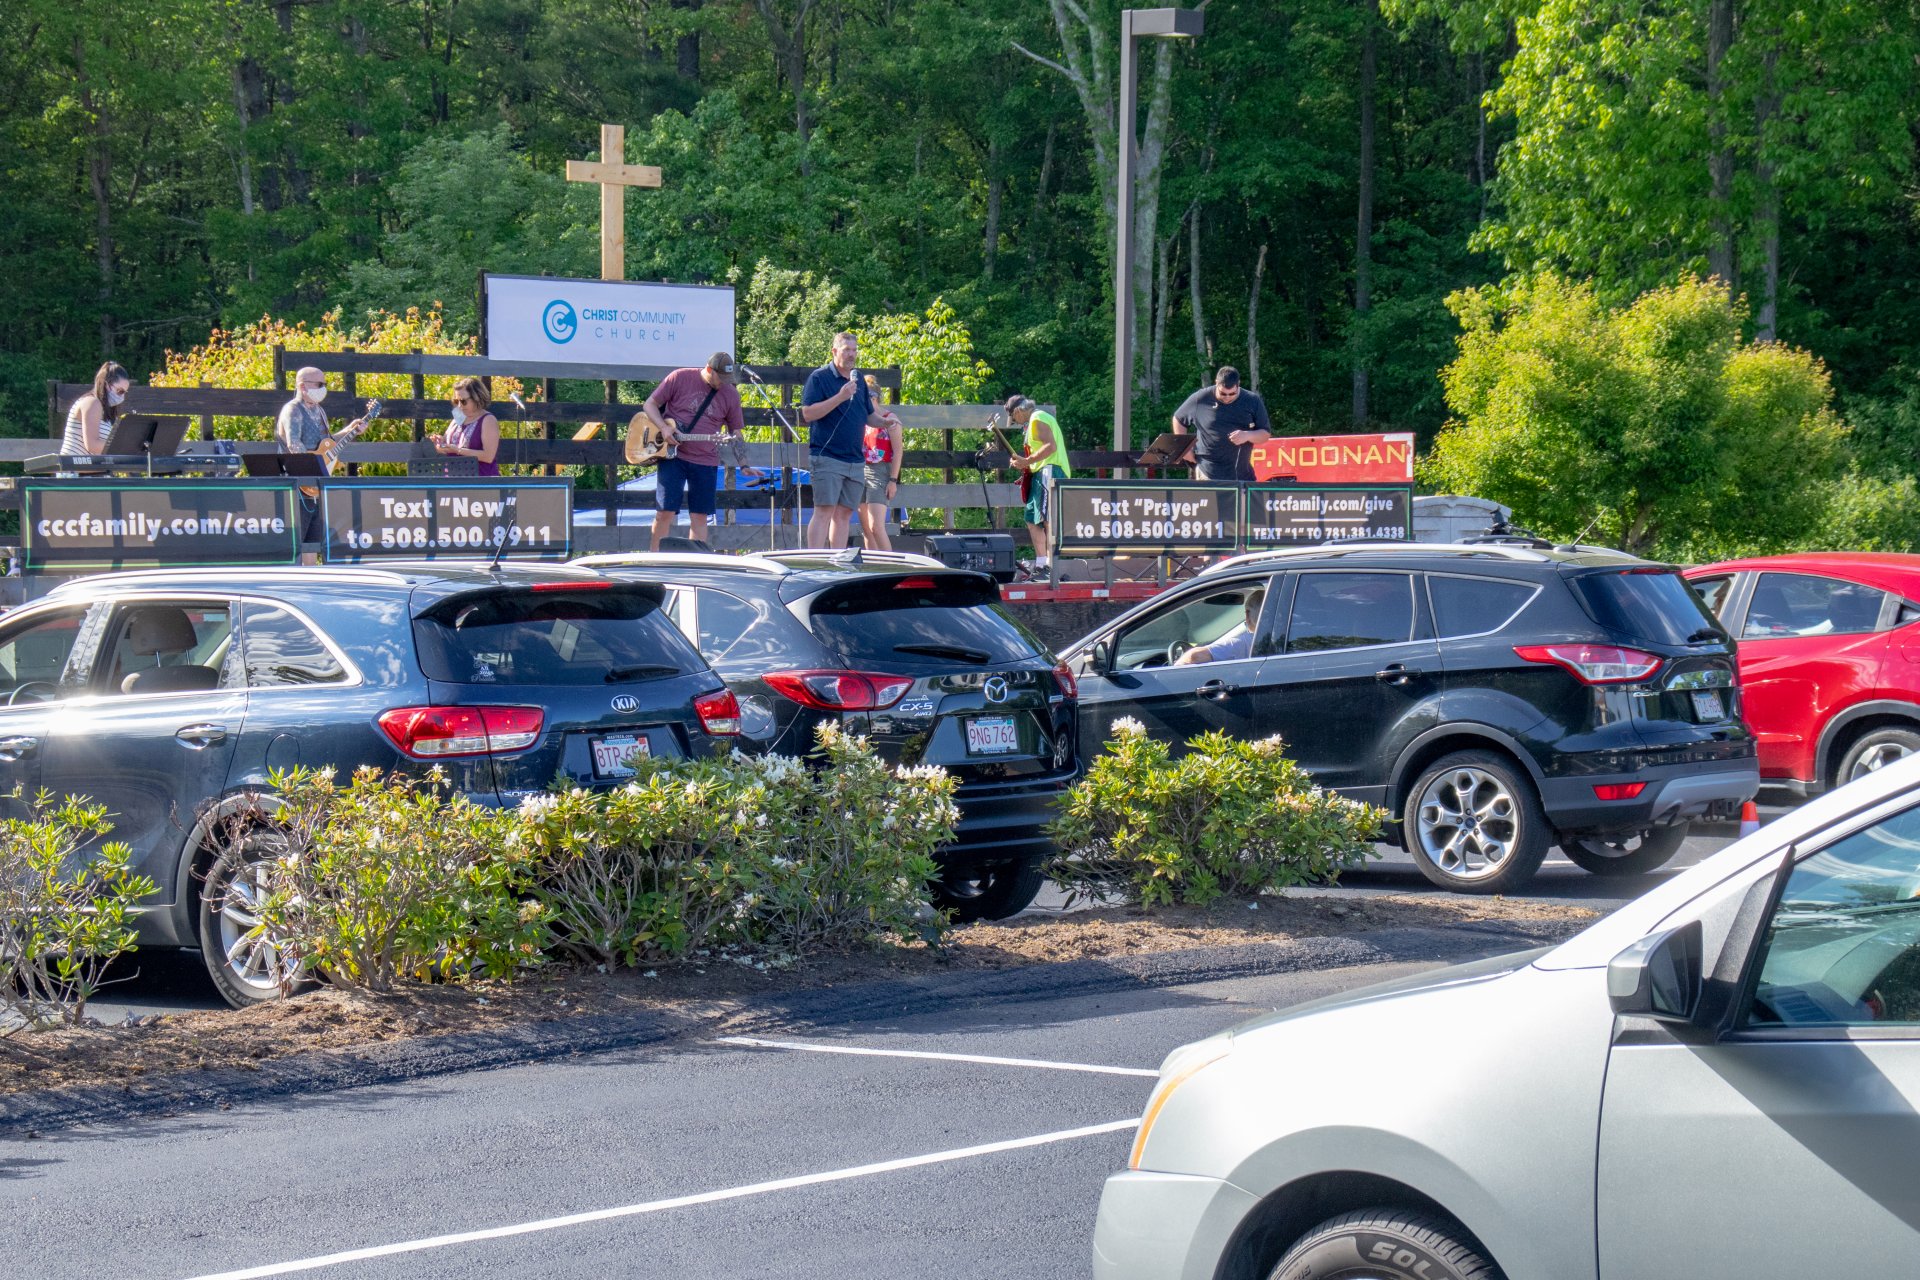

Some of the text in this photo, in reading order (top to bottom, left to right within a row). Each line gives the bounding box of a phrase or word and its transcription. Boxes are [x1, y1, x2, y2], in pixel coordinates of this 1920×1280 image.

[582, 308, 686, 324] CHRIST COMMUNITY
[595, 327, 675, 341] CHURCH
[73, 456, 92, 465] KORG
[380, 498, 432, 518] Text
[1091, 498, 1130, 516] Text
[1266, 496, 1392, 514] cccfamily.com/give
[38, 511, 285, 542] cccfamily.com/care
[1076, 520, 1224, 538] to 508-500-8911
[1253, 528, 1282, 540] TEXT
[1306, 528, 1322, 540] TO
[1325, 526, 1404, 540] 781.381.4338
[346, 526, 550, 549] to 508.500.8911
[616, 698, 638, 710] KIA
[900, 702, 934, 712] CX-5
[968, 726, 1016, 746] 9NG 762
[596, 746, 621, 768] 8TP
